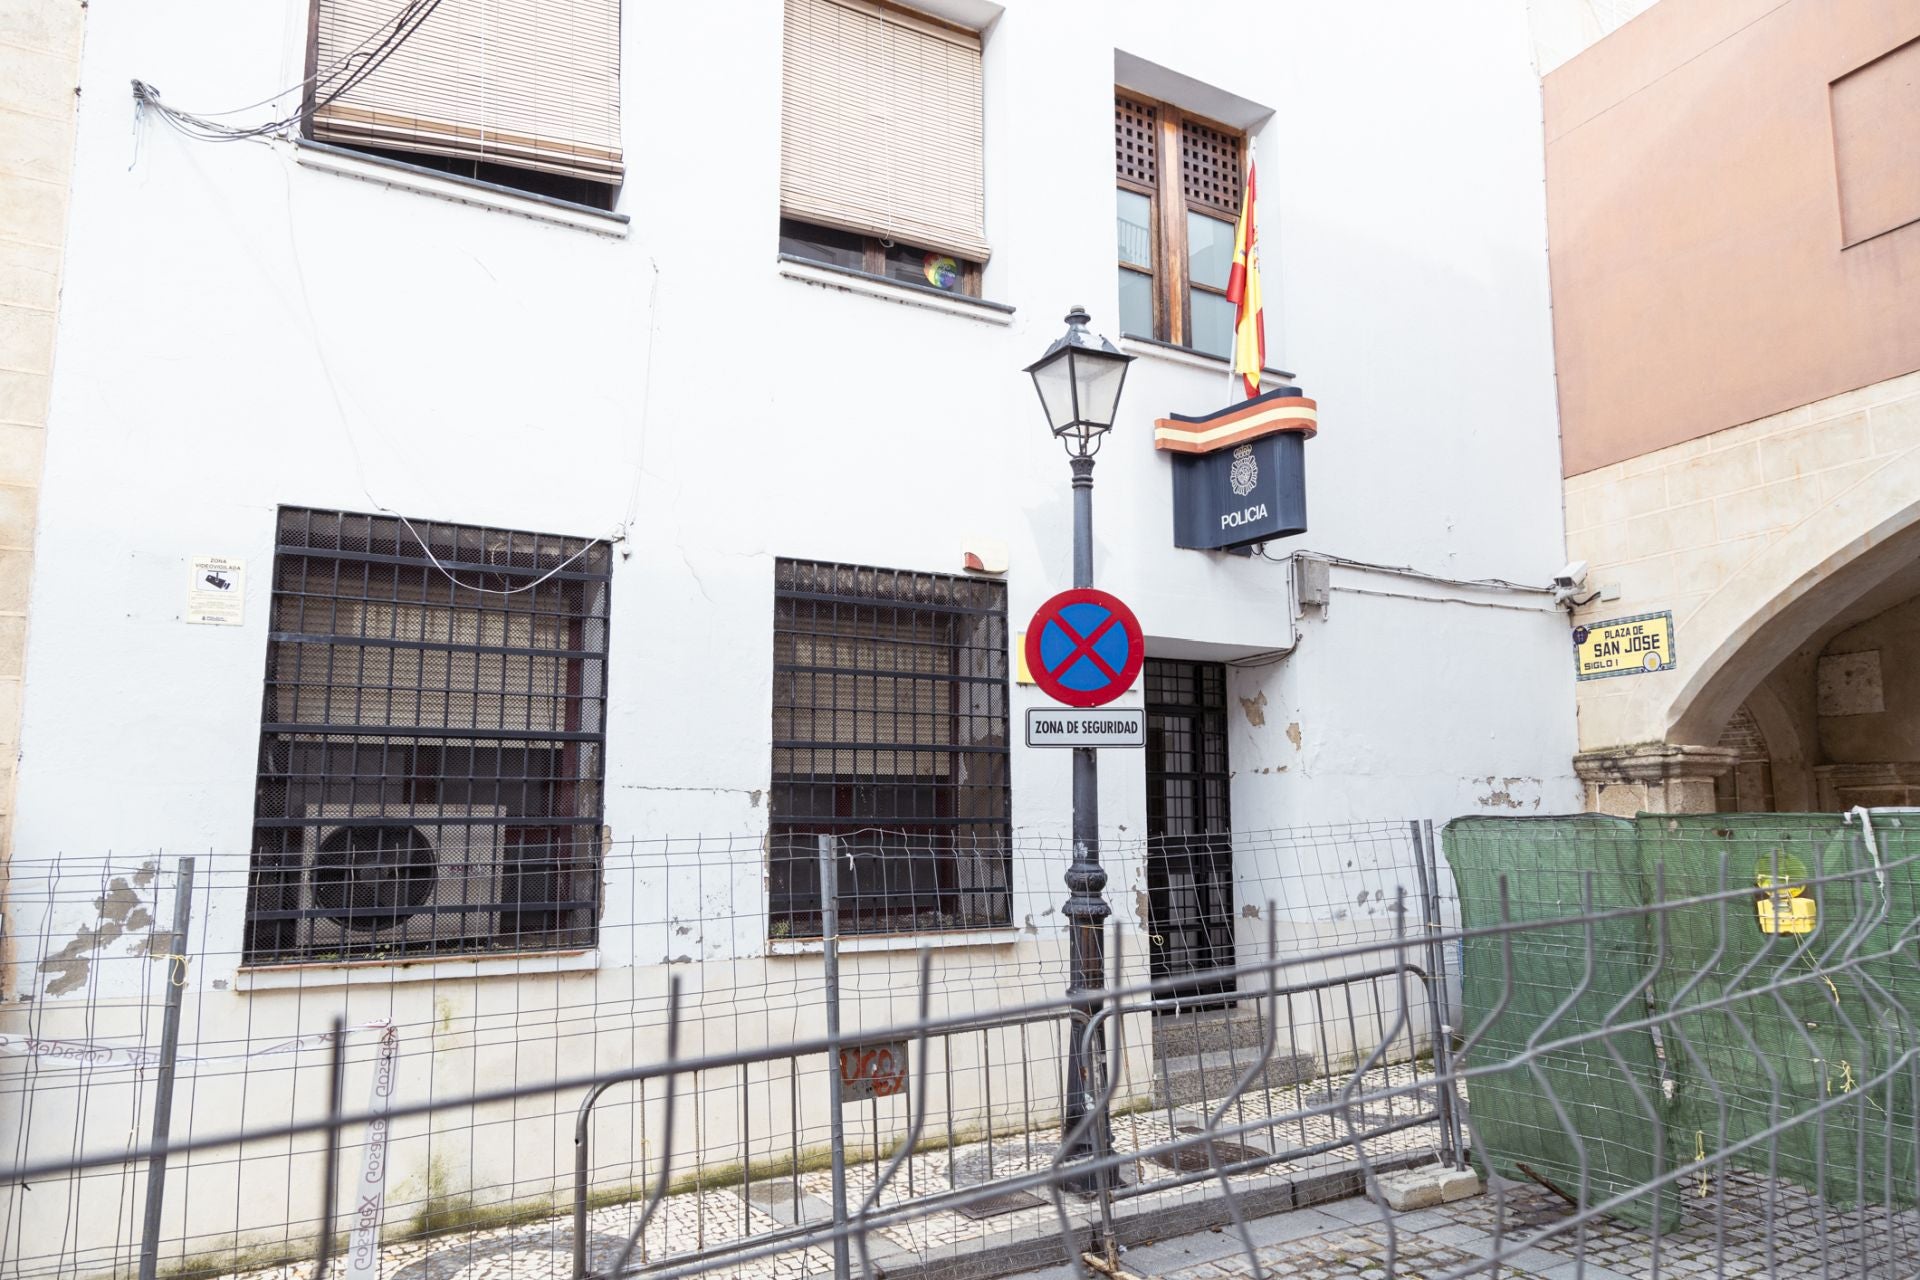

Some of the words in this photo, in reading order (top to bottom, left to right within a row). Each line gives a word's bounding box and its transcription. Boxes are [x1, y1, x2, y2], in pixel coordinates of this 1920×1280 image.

[1221, 503, 1268, 530] POLICIA
[1604, 627, 1631, 639] PLAZA
[1632, 625, 1644, 635] DE
[1594, 640, 1620, 658] SAN
[1624, 633, 1660, 653] JOSE
[1584, 660, 1613, 670] SIGLO
[1035, 720, 1064, 734] ZONA
[1066, 720, 1079, 734] DE
[1081, 720, 1138, 734] SEGURIDAD
